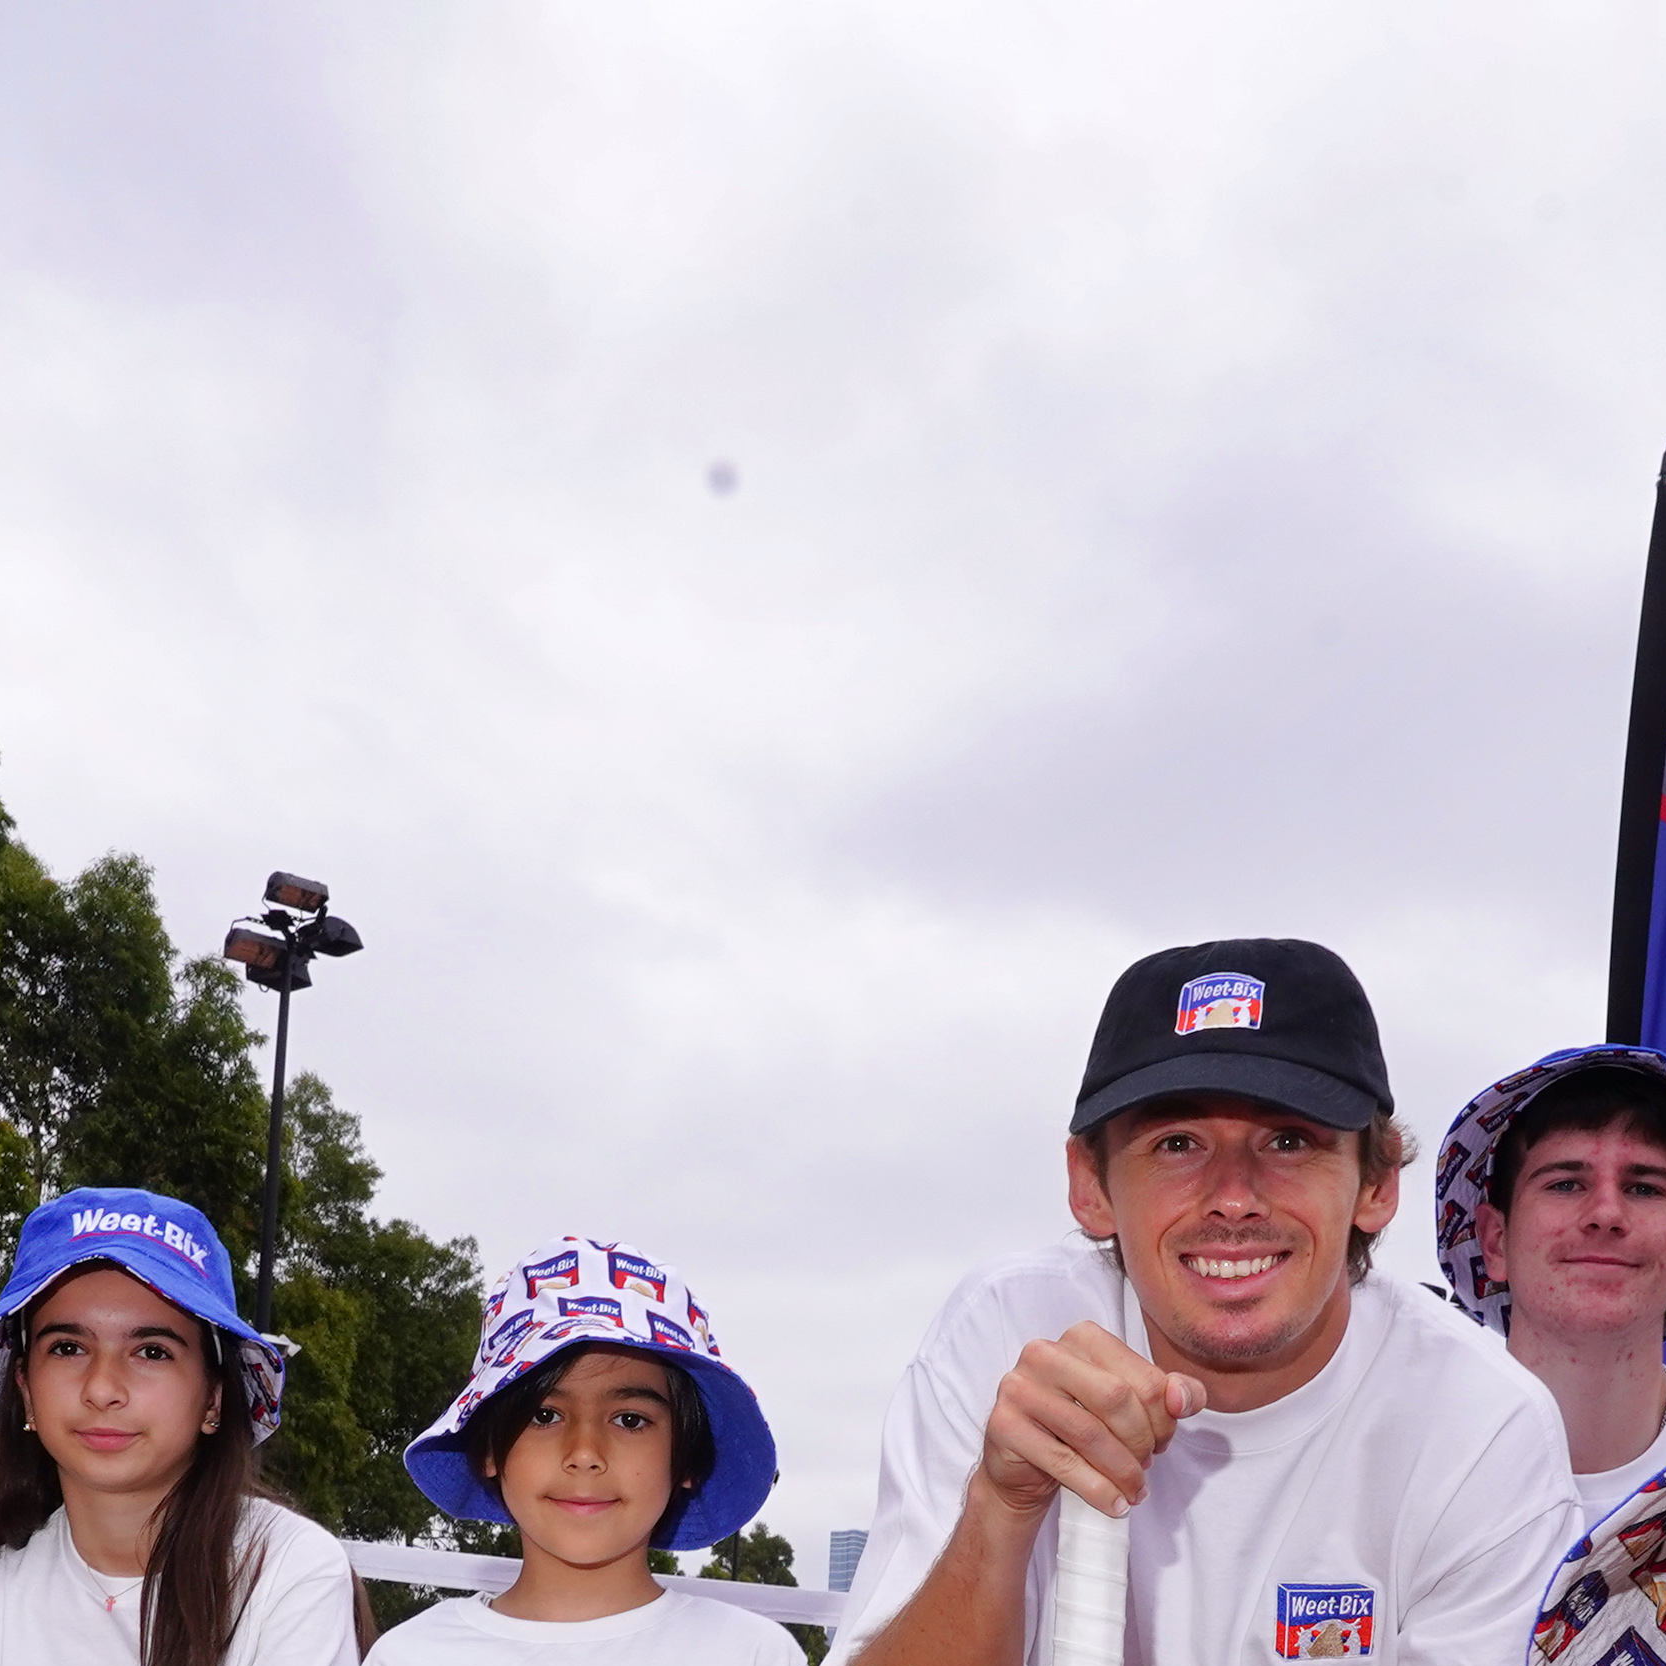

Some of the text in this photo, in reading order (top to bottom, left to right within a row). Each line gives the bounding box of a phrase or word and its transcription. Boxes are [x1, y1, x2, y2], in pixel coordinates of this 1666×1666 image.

[1192, 980, 1260, 1003] Weet-Bix
[70, 1207, 209, 1270] Weet-Bix
[526, 1257, 577, 1280] Weet-Bix
[615, 1258, 665, 1281] Weet-Bix
[1291, 1593, 1372, 1618] Weet-Bix
